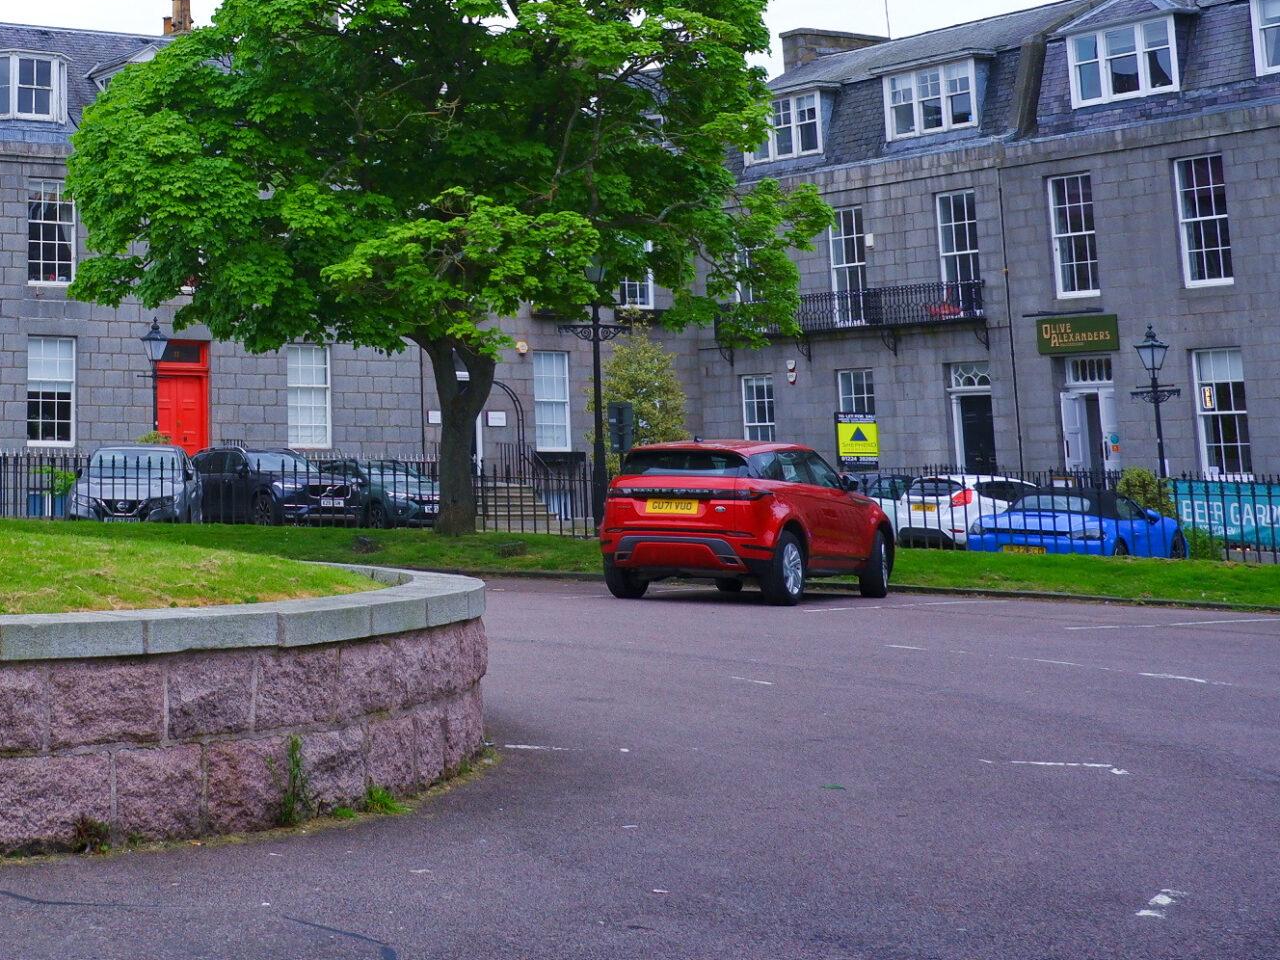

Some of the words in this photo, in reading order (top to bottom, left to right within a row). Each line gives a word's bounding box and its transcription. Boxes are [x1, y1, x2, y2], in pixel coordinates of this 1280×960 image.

[1042, 323, 1072, 339] OLIVE
[1050, 331, 1111, 347] ALEXANDERS
[652, 501, 673, 510] GU71
[1182, 499, 1224, 524] BEER
